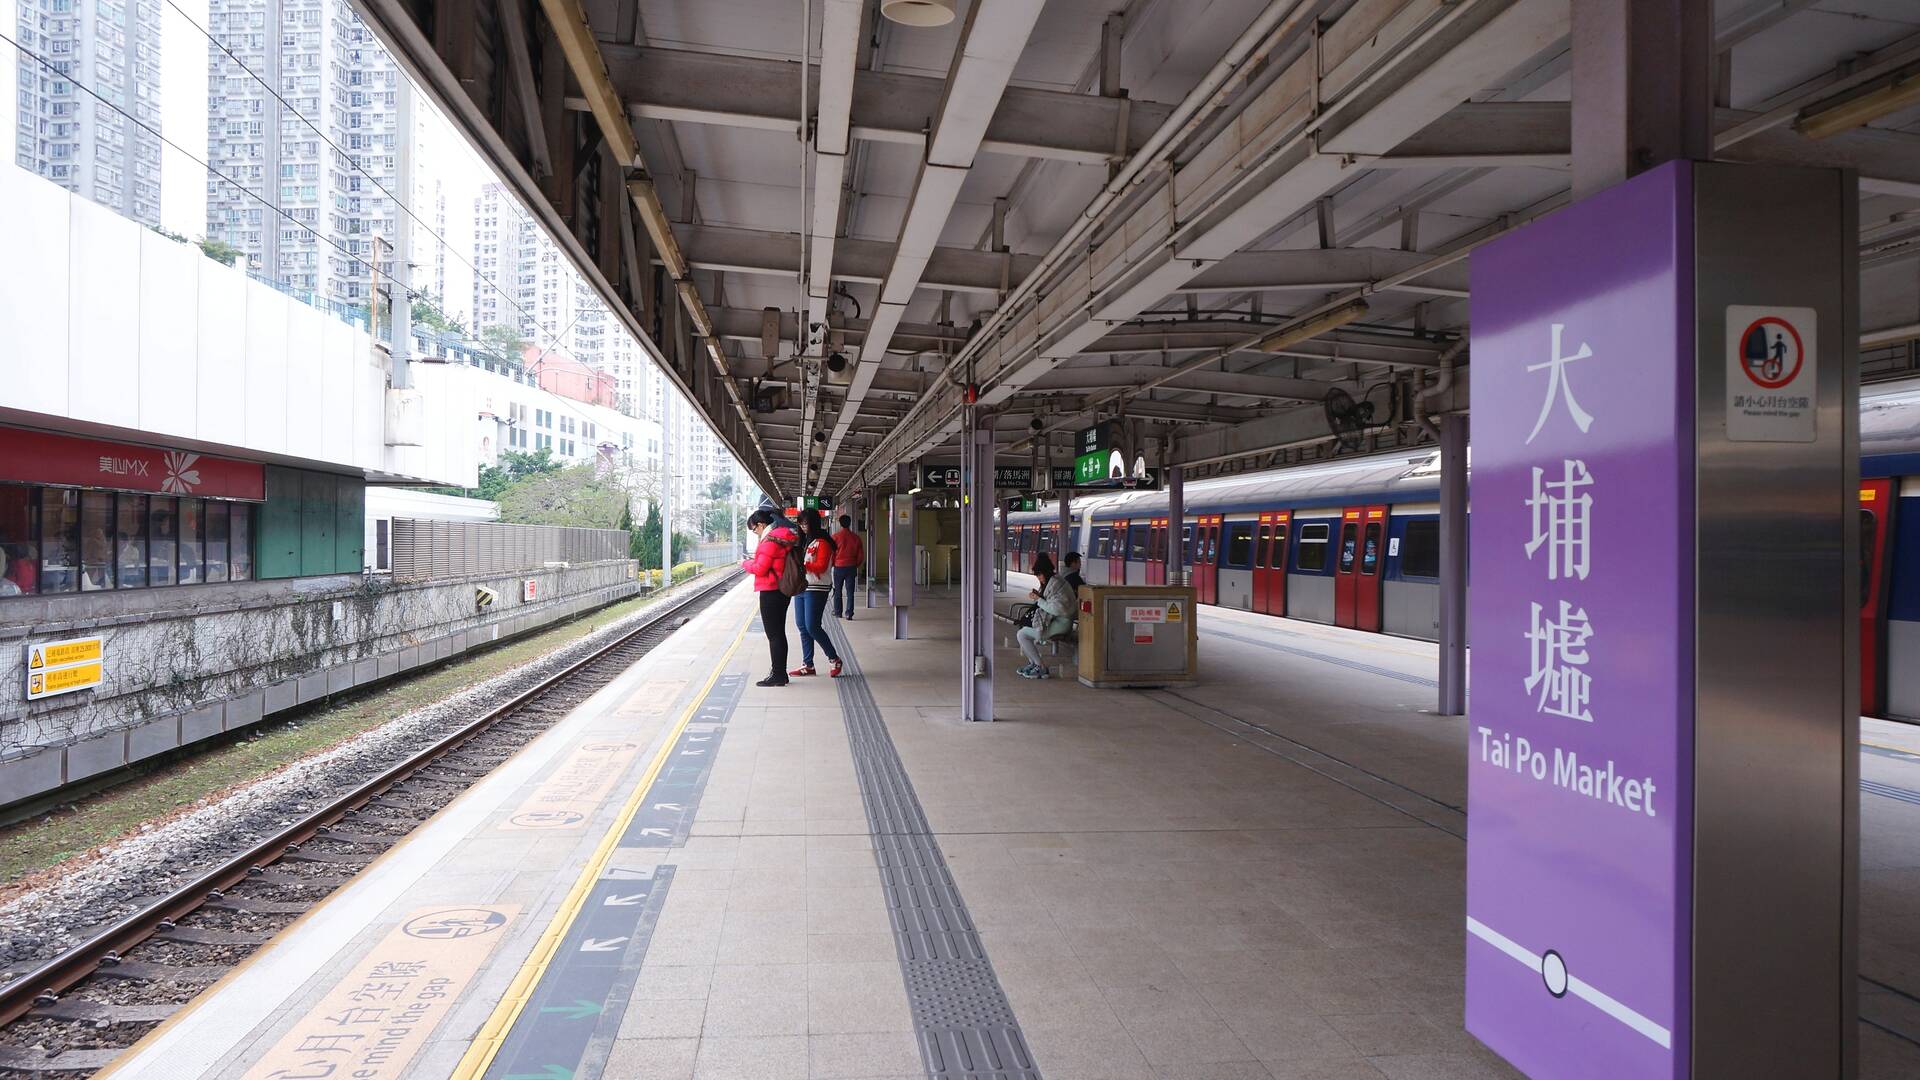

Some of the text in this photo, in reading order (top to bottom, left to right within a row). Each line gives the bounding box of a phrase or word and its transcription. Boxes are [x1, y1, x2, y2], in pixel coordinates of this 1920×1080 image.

[1524, 323, 1595, 722] 大埔墟
[1478, 726, 1656, 816] Tai Po Market
[361, 1028, 413, 1065] mind
[391, 1003, 431, 1025] the
[417, 977, 456, 1000] gap
